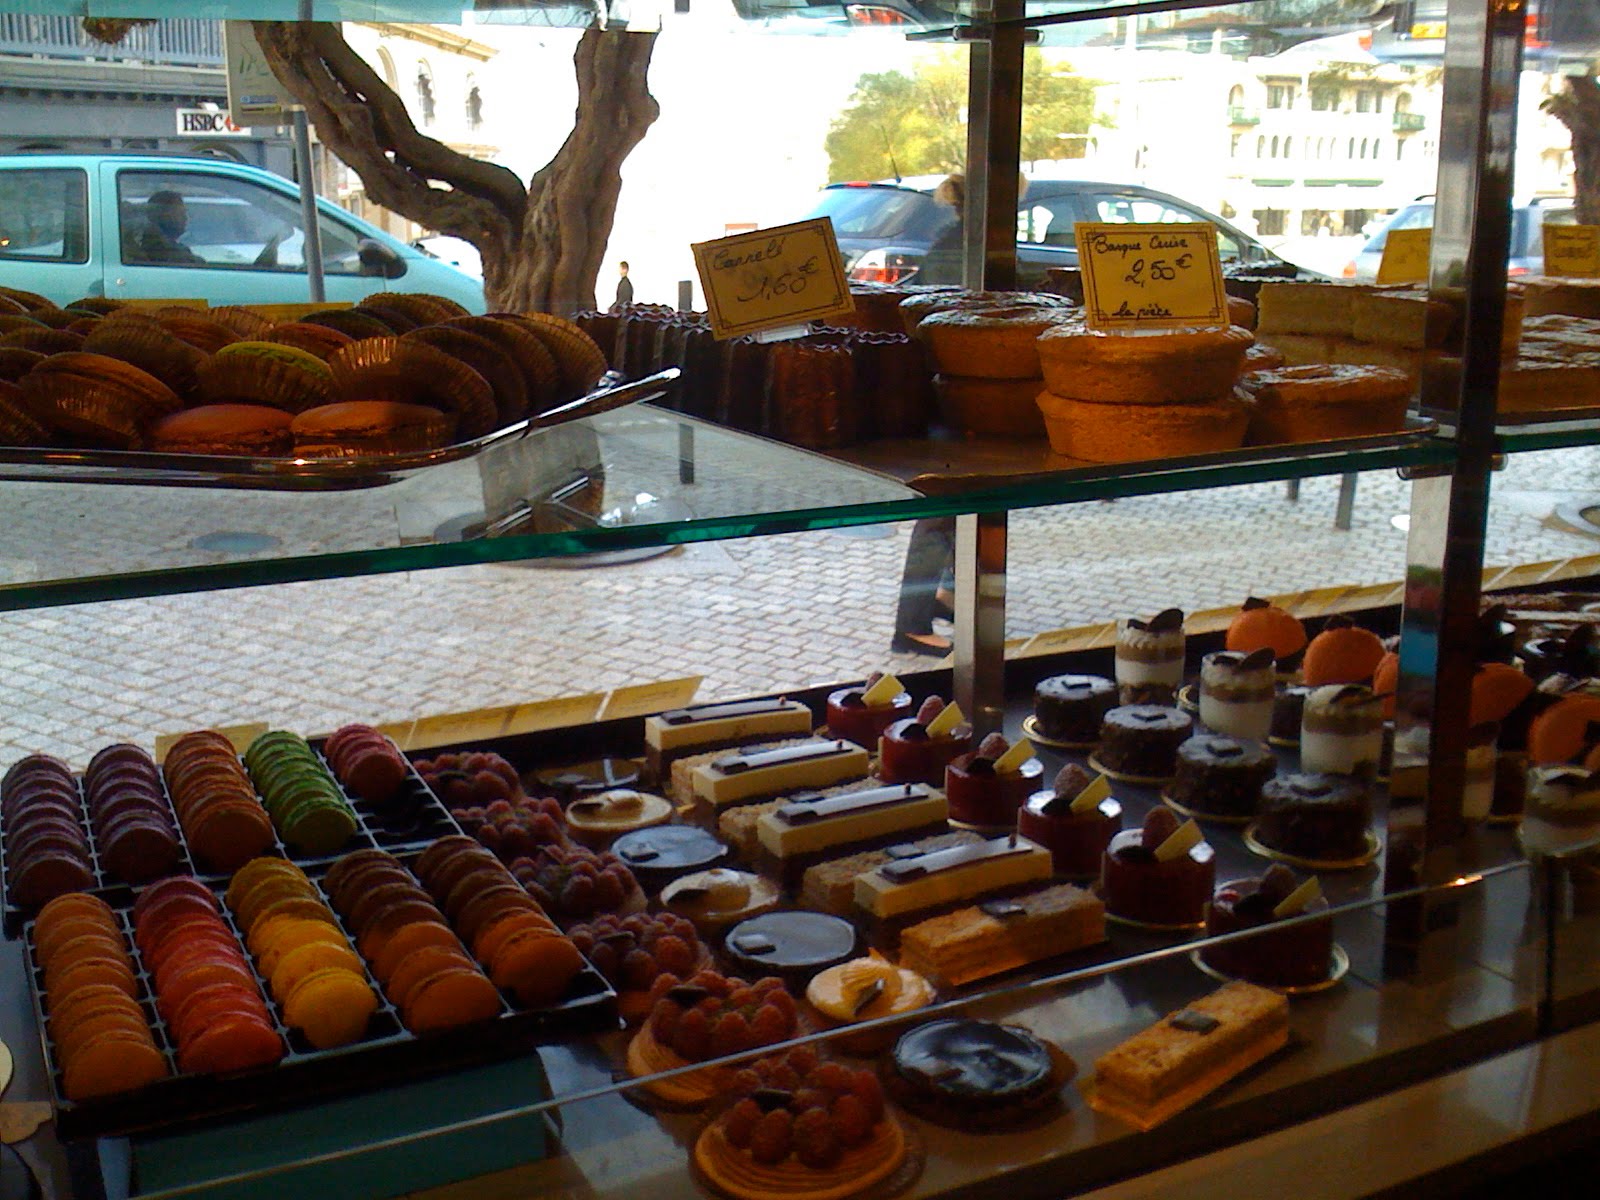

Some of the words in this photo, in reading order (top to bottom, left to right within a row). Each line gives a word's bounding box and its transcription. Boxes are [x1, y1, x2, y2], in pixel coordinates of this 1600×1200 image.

[182, 113, 224, 132] HSBC
[1093, 234, 1142, 259] Basque
[1112, 301, 1135, 317] la
